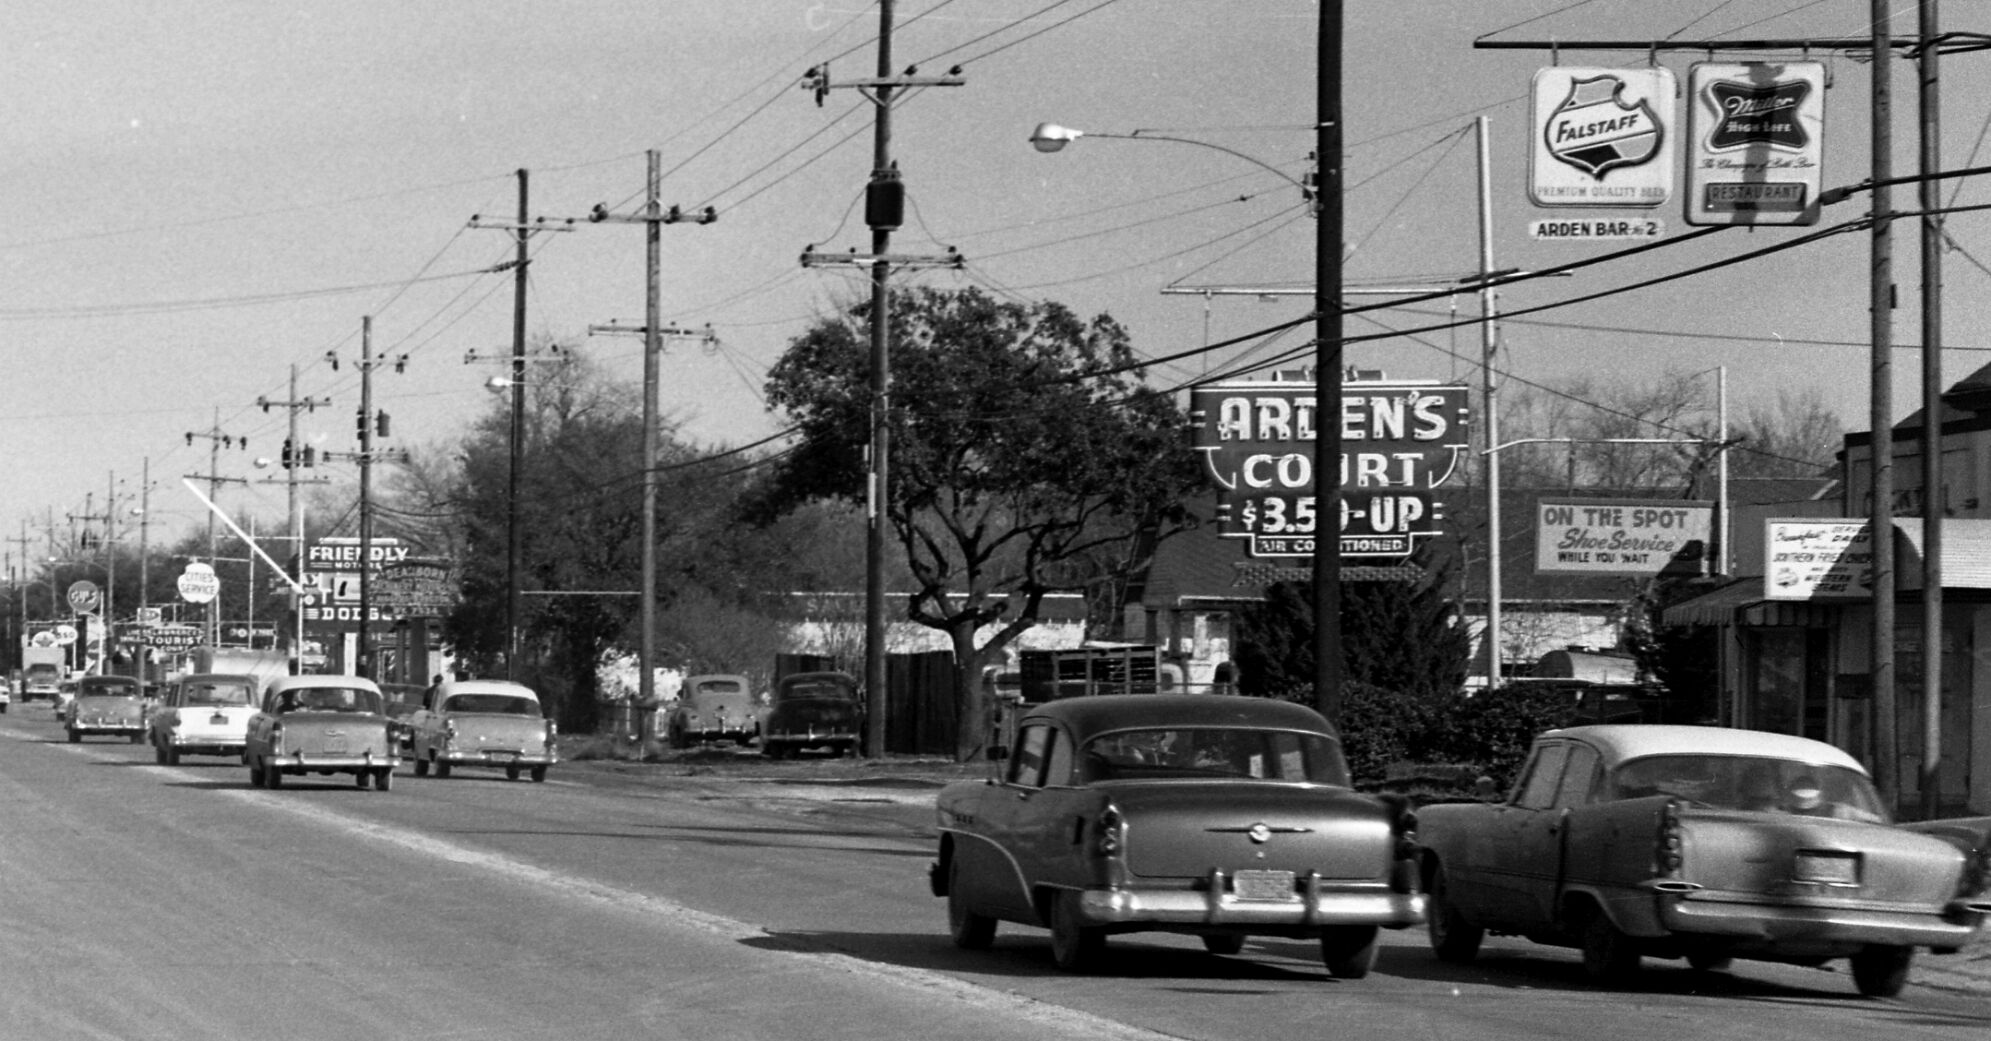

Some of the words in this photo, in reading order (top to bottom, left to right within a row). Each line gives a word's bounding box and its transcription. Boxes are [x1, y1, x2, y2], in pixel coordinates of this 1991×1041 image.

[1724, 95, 1796, 117] Miller
[1556, 113, 1640, 144] FALSTAFF
[1537, 187, 1587, 198] PREMIUM
[1592, 187, 1636, 198] QUALITY
[1711, 186, 1800, 200] RESTAURANT
[1537, 222, 1591, 237] ARDEN
[1595, 222, 1630, 236] BAR
[1646, 221, 1658, 236] 2
[1218, 390, 1448, 441] ARDEN'S
[1243, 453, 1424, 488] CORT
[1543, 507, 1574, 526] ON
[1583, 508, 1623, 527] THE
[1632, 509, 1689, 529] SPOT
[1261, 540, 1287, 552] AIR
[1293, 539, 1403, 552] COITIONED
[1557, 527, 1607, 551] Shoe
[1606, 530, 1675, 552] Service
[1558, 551, 1590, 563] WHILE
[1596, 552, 1616, 563] YOU
[1620, 553, 1649, 564] WAIT
[334, 561, 383, 570] MOTRS
[185, 571, 214, 583] CITIES
[180, 583, 216, 595] SERVICE
[147, 636, 204, 645] TOURIST
